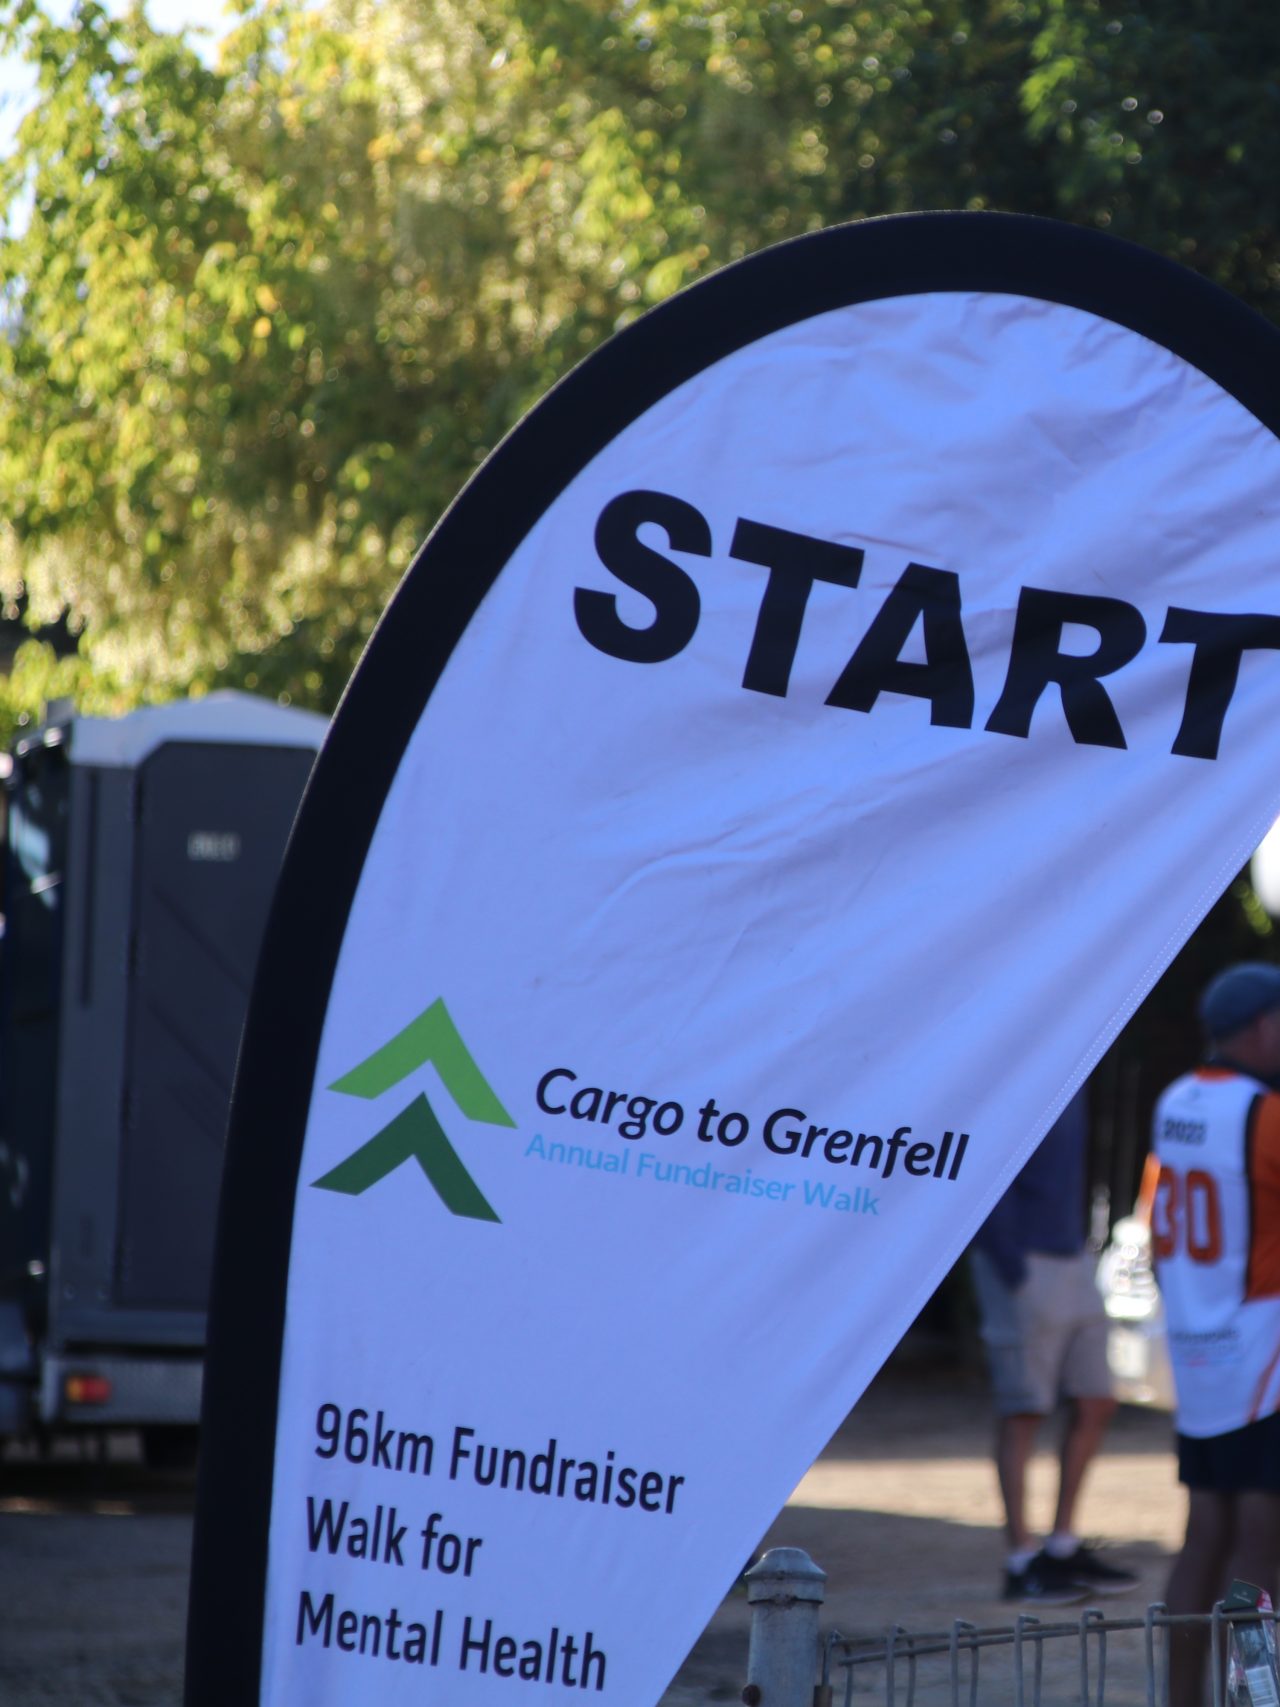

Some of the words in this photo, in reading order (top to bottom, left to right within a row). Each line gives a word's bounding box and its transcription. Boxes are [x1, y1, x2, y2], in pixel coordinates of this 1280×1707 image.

[524, 1133, 630, 1175] Annual
[636, 1152, 796, 1202] Fundraiser
[802, 1179, 881, 1217] Walk
[536, 1068, 685, 1140] Cargo
[697, 1098, 750, 1147] to
[762, 1108, 970, 1181] Grenfell
[315, 1403, 434, 1476] 96km
[450, 1426, 686, 1515] Fundraiser
[306, 1496, 408, 1567] Walk
[420, 1512, 484, 1577] for
[295, 1590, 444, 1667] Mental
[459, 1615, 607, 1692] Health
